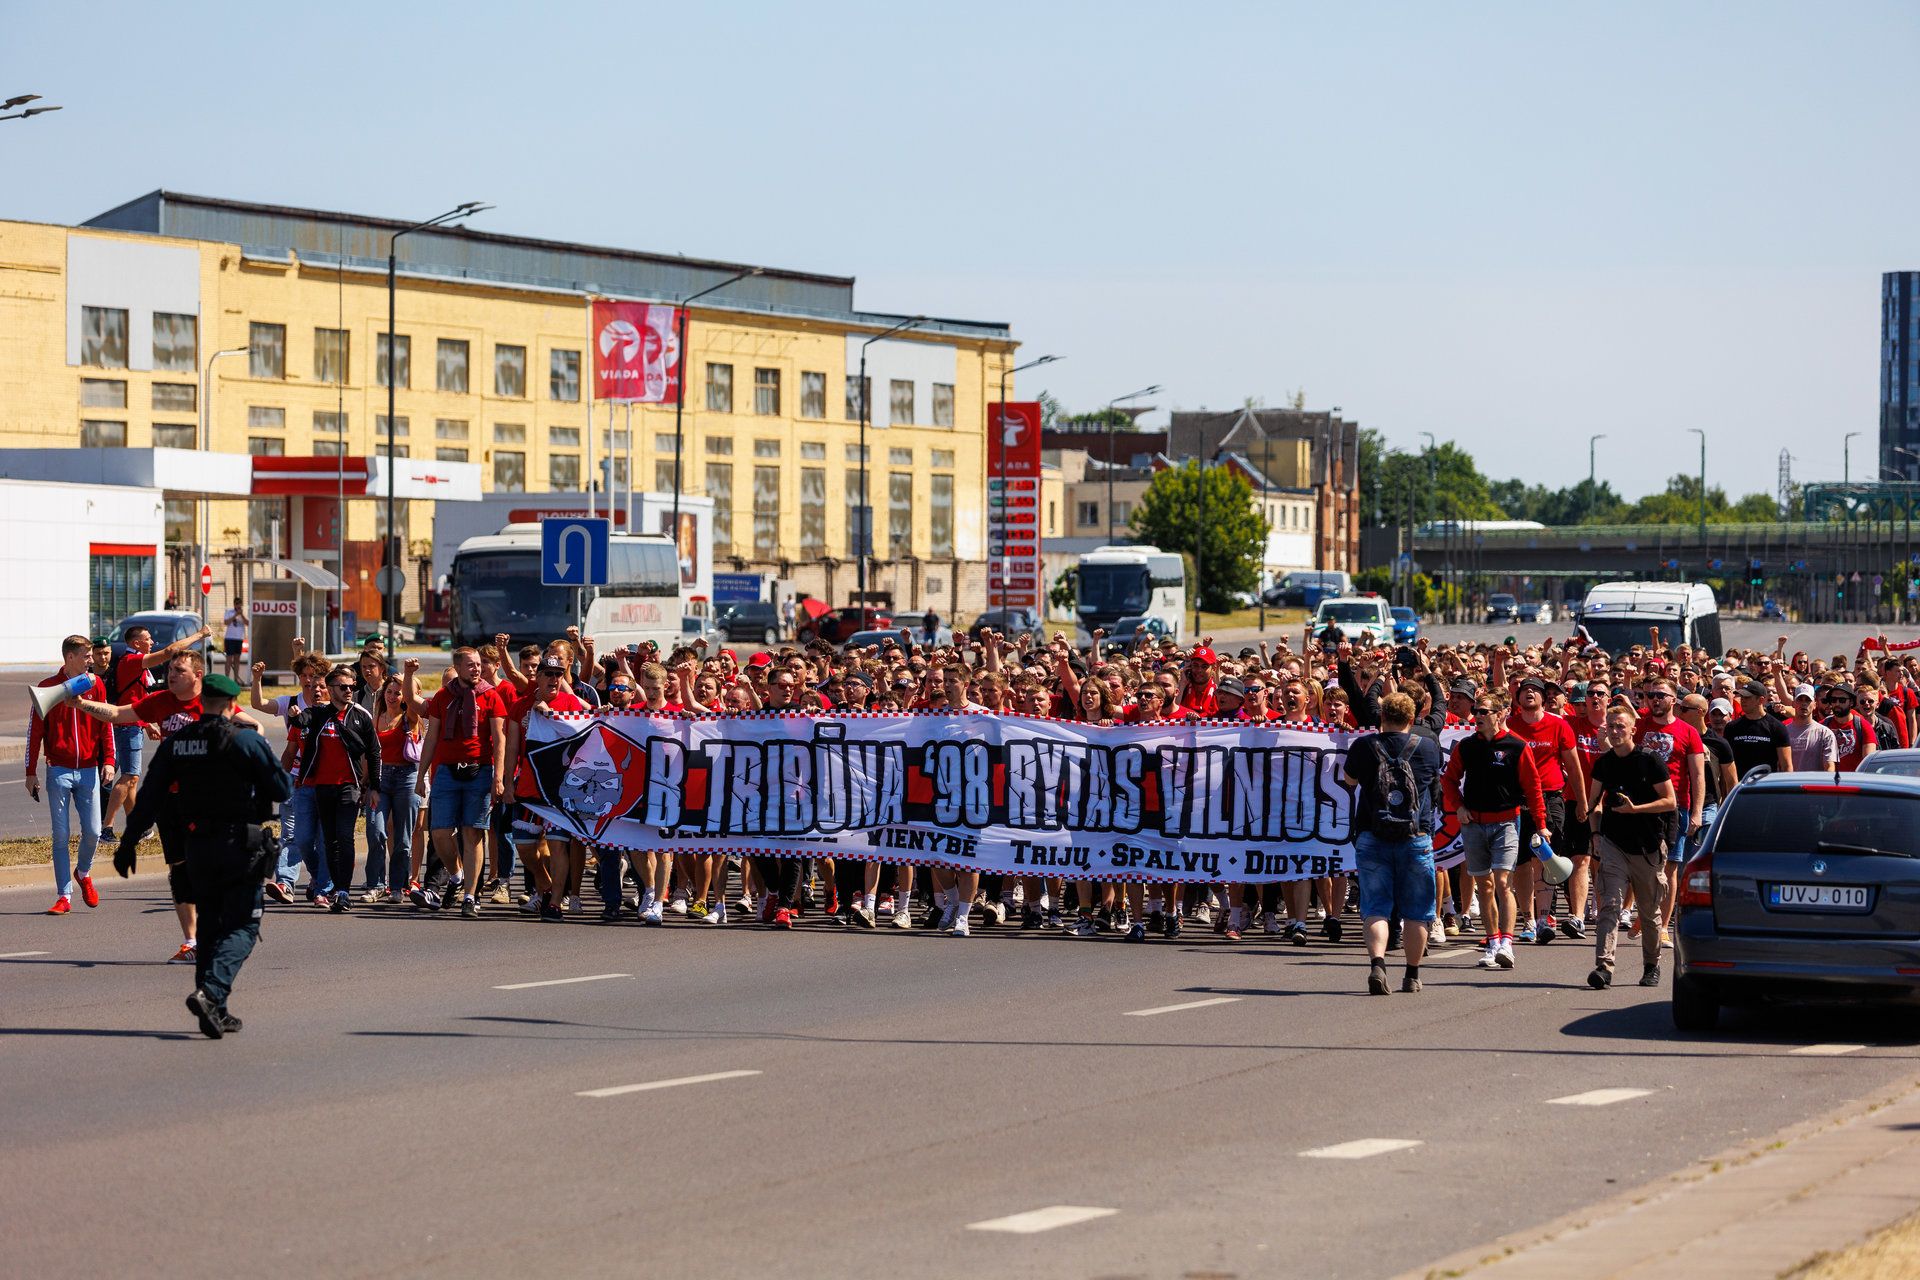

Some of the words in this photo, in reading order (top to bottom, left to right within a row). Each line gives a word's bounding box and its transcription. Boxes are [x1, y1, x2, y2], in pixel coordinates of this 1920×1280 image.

[600, 369, 639, 380] VIADA
[994, 461, 1031, 470] VADA
[252, 602, 297, 614] DUJOS
[645, 737, 685, 828] B
[702, 723, 905, 834] TRIBŪNA
[1007, 738, 1144, 833] RYTAS
[1157, 746, 1352, 844] VILNIUS
[1781, 886, 1820, 903] UVJ
[1832, 888, 1864, 904] 010
